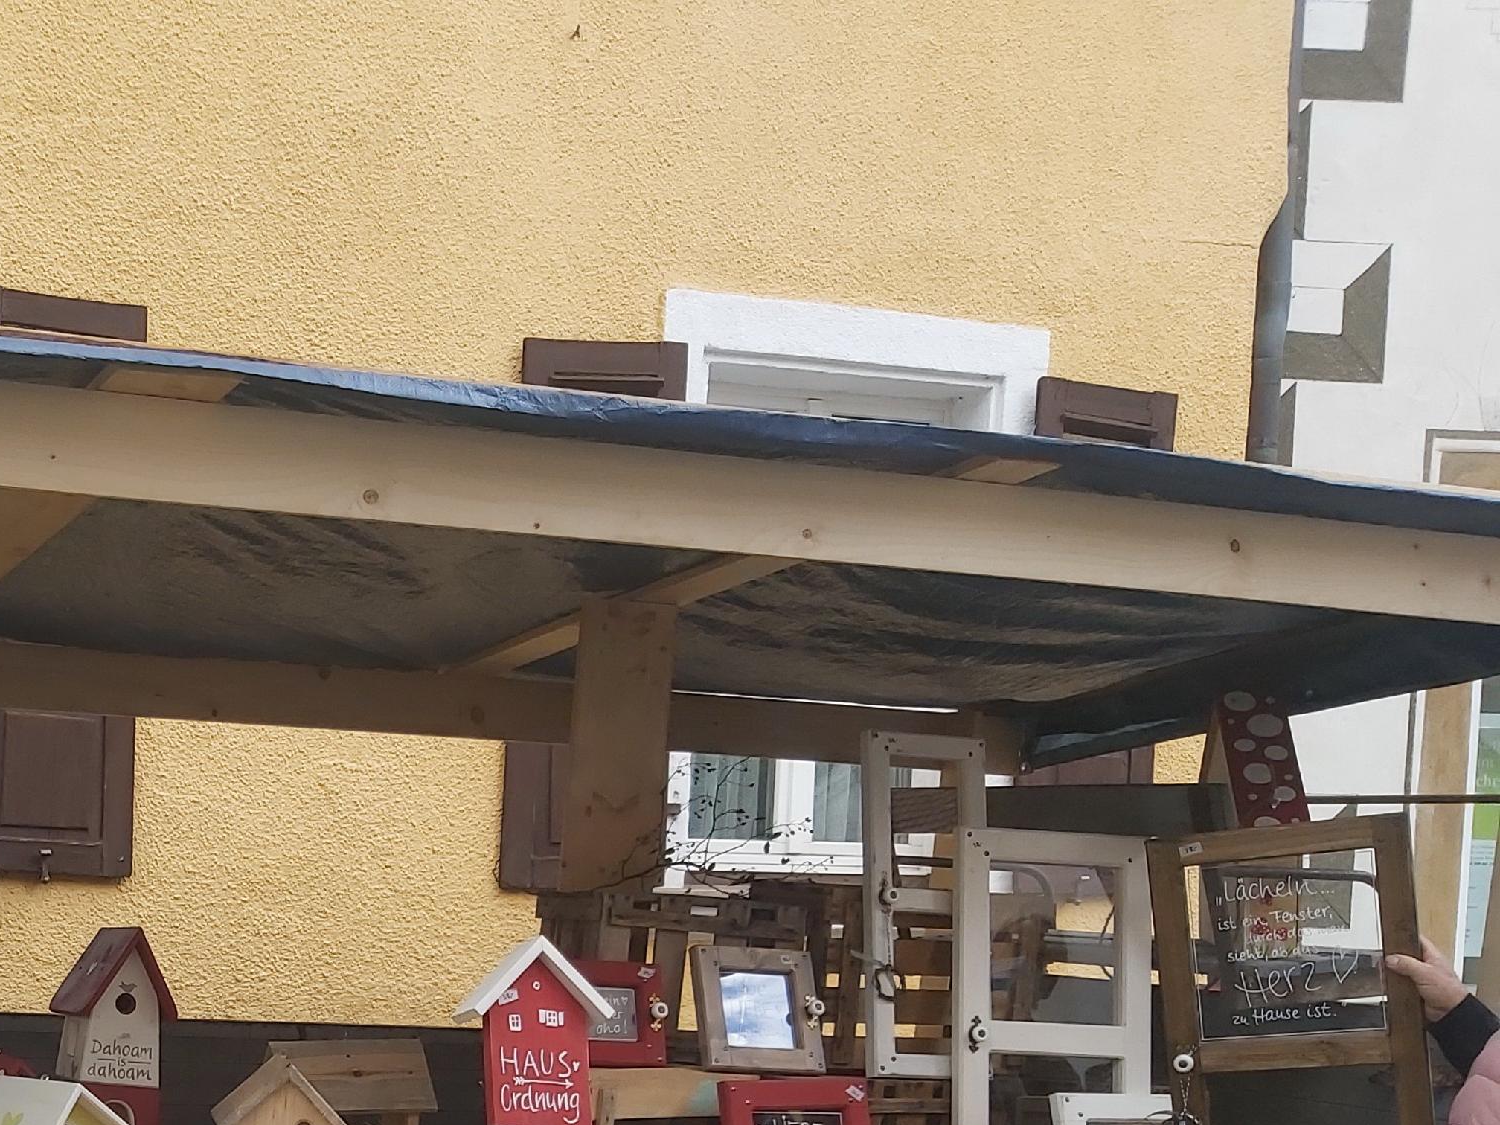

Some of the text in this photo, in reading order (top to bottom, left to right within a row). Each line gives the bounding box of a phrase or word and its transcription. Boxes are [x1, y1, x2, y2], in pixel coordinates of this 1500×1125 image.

[1217, 918, 1237, 931] ist
[1234, 961, 1323, 1008] Herz
[1232, 1014, 1250, 1026] zu
[1252, 1008, 1300, 1025] Hause
[90, 1039, 153, 1060] Dahoam
[87, 1062, 152, 1081] dahoam
[116, 1056, 126, 1067] is
[500, 1045, 572, 1079] HAUS
[500, 1083, 580, 1125] Ordnung
